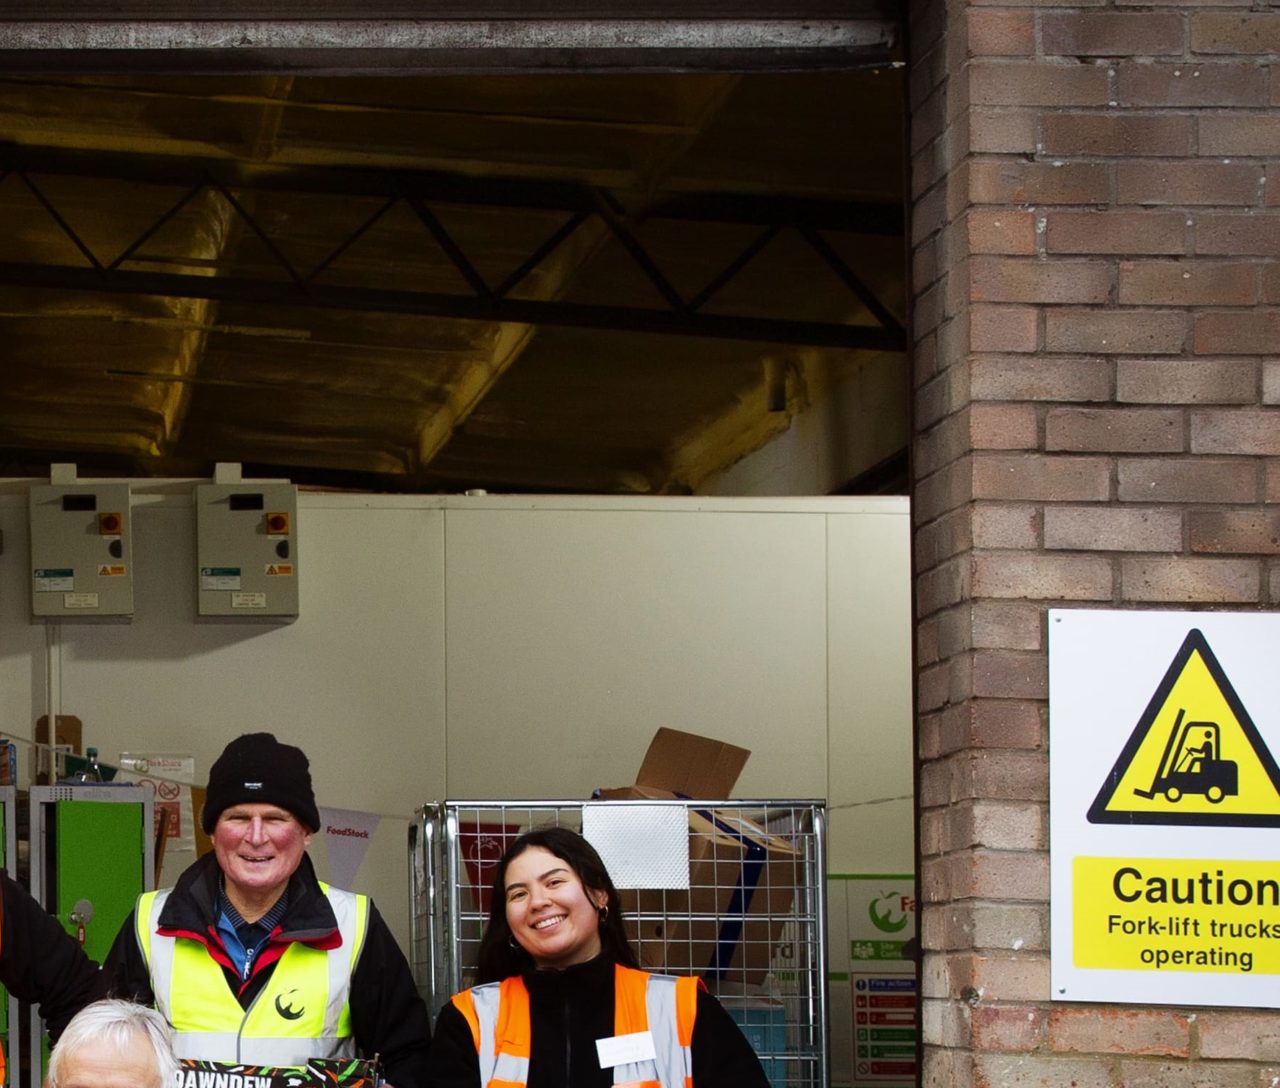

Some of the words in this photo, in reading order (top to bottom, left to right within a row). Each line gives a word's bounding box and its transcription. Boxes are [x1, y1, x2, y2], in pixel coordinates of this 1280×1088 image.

[326, 826, 369, 839] FoodStock
[1112, 867, 1280, 907] Caution
[1107, 914, 1201, 937] Fork-lift
[1210, 919, 1280, 939] trucks
[1140, 947, 1253, 972] operating
